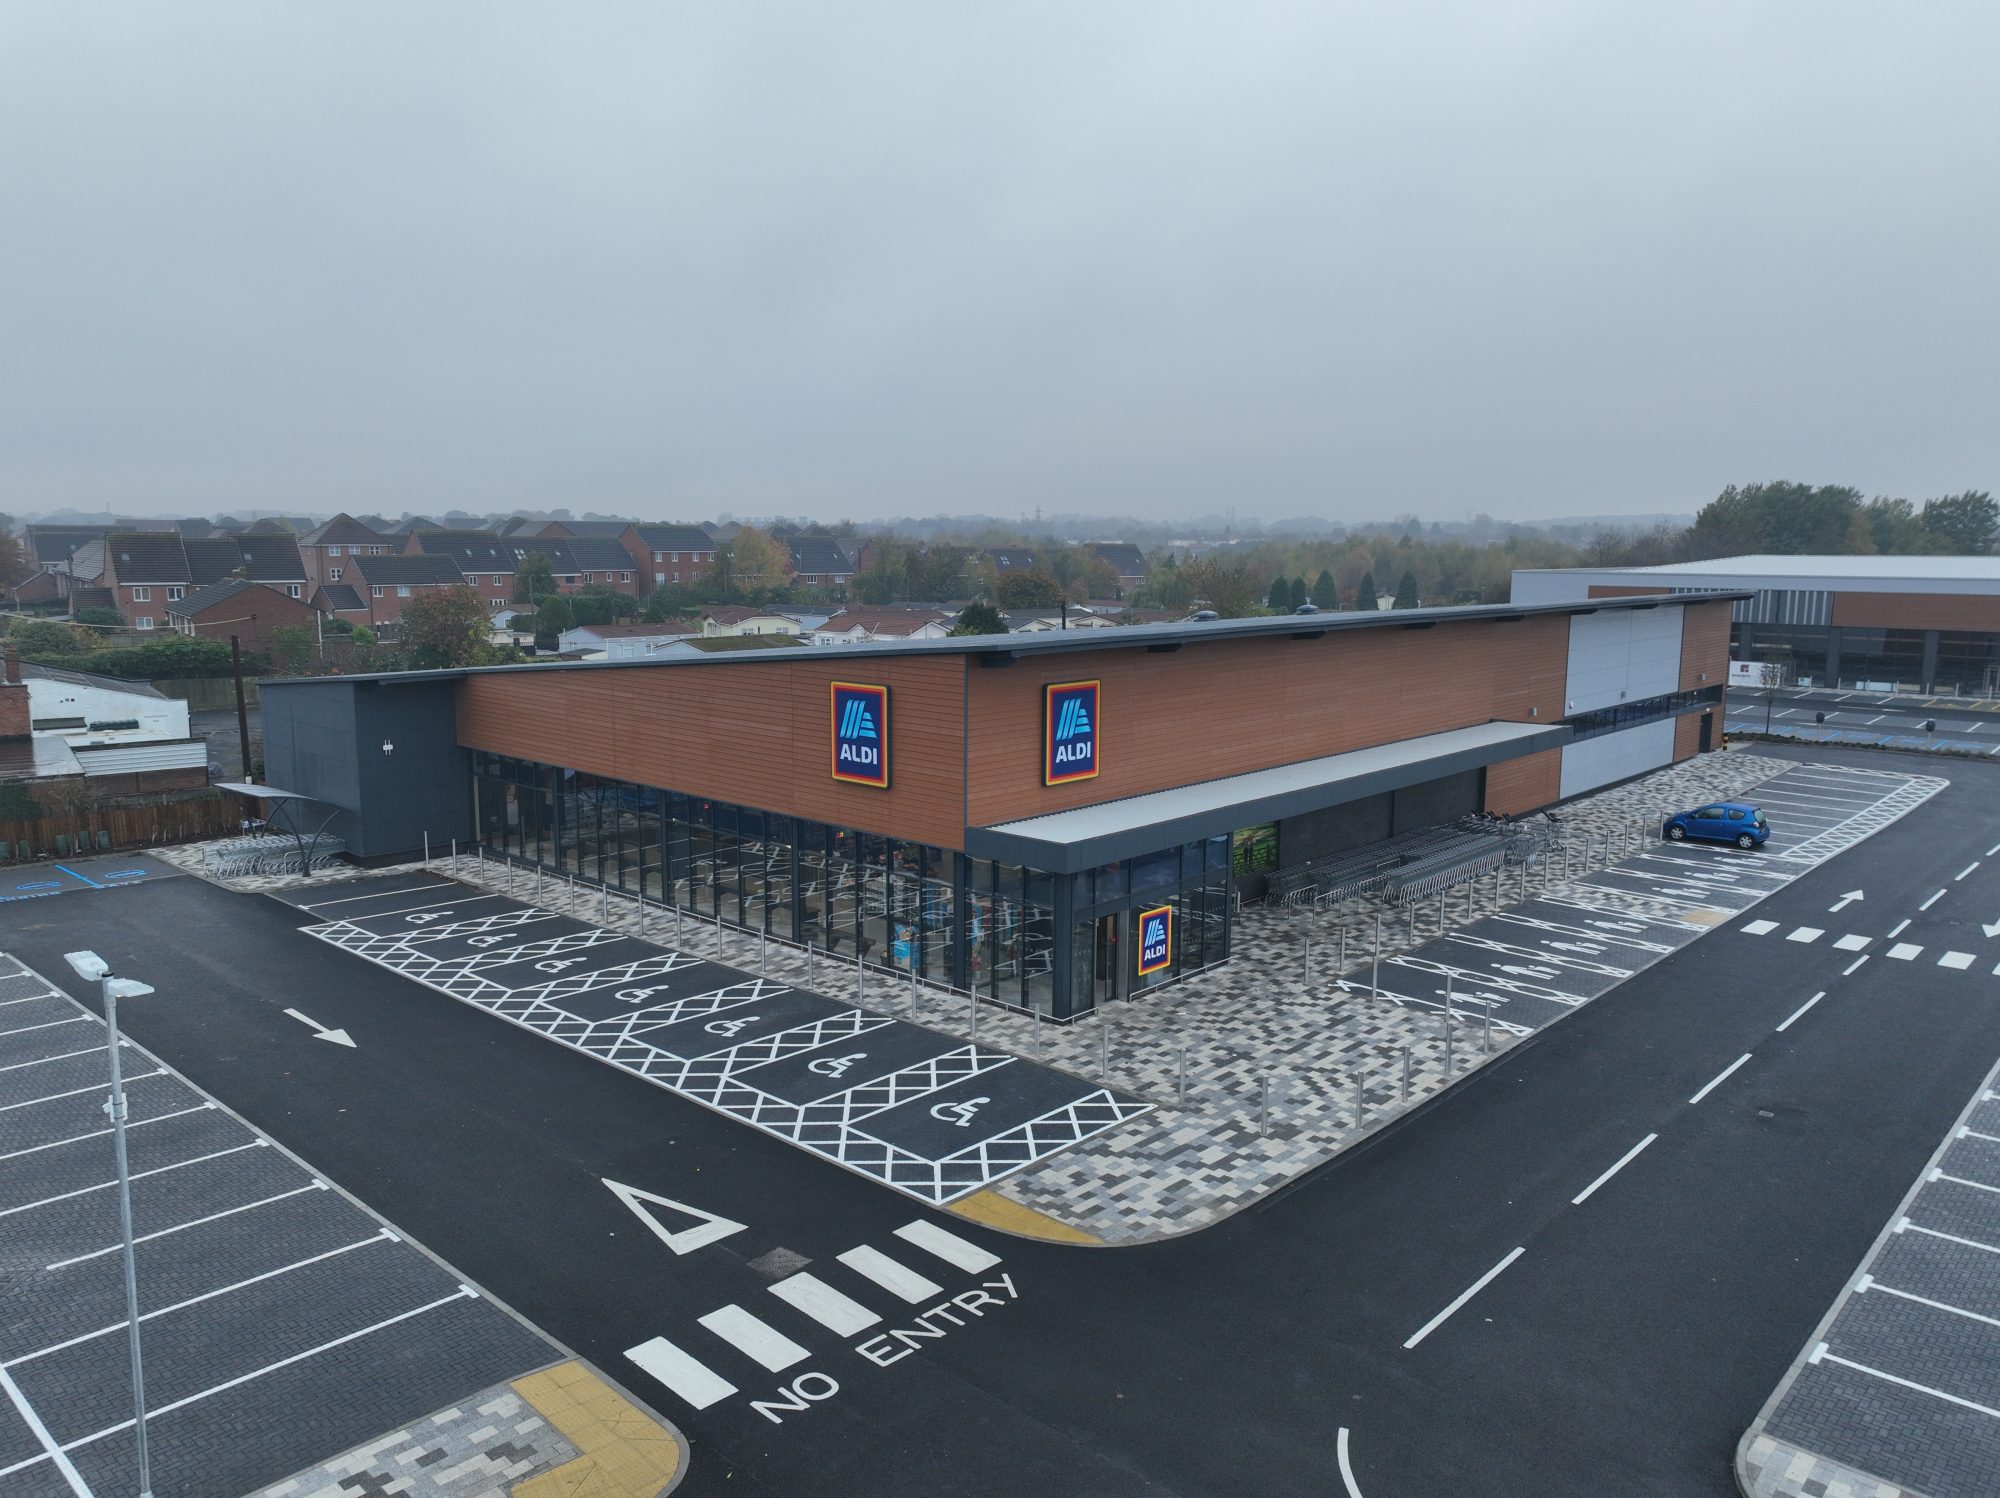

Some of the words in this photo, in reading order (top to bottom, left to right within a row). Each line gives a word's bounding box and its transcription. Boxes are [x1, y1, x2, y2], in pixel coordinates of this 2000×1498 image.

[840, 743, 878, 765] ALDI
[1055, 741, 1091, 763] ALDI
[1143, 943, 1166, 961] ALDI
[749, 1371, 840, 1424] NO
[854, 1273, 1019, 1367] ENTRY
